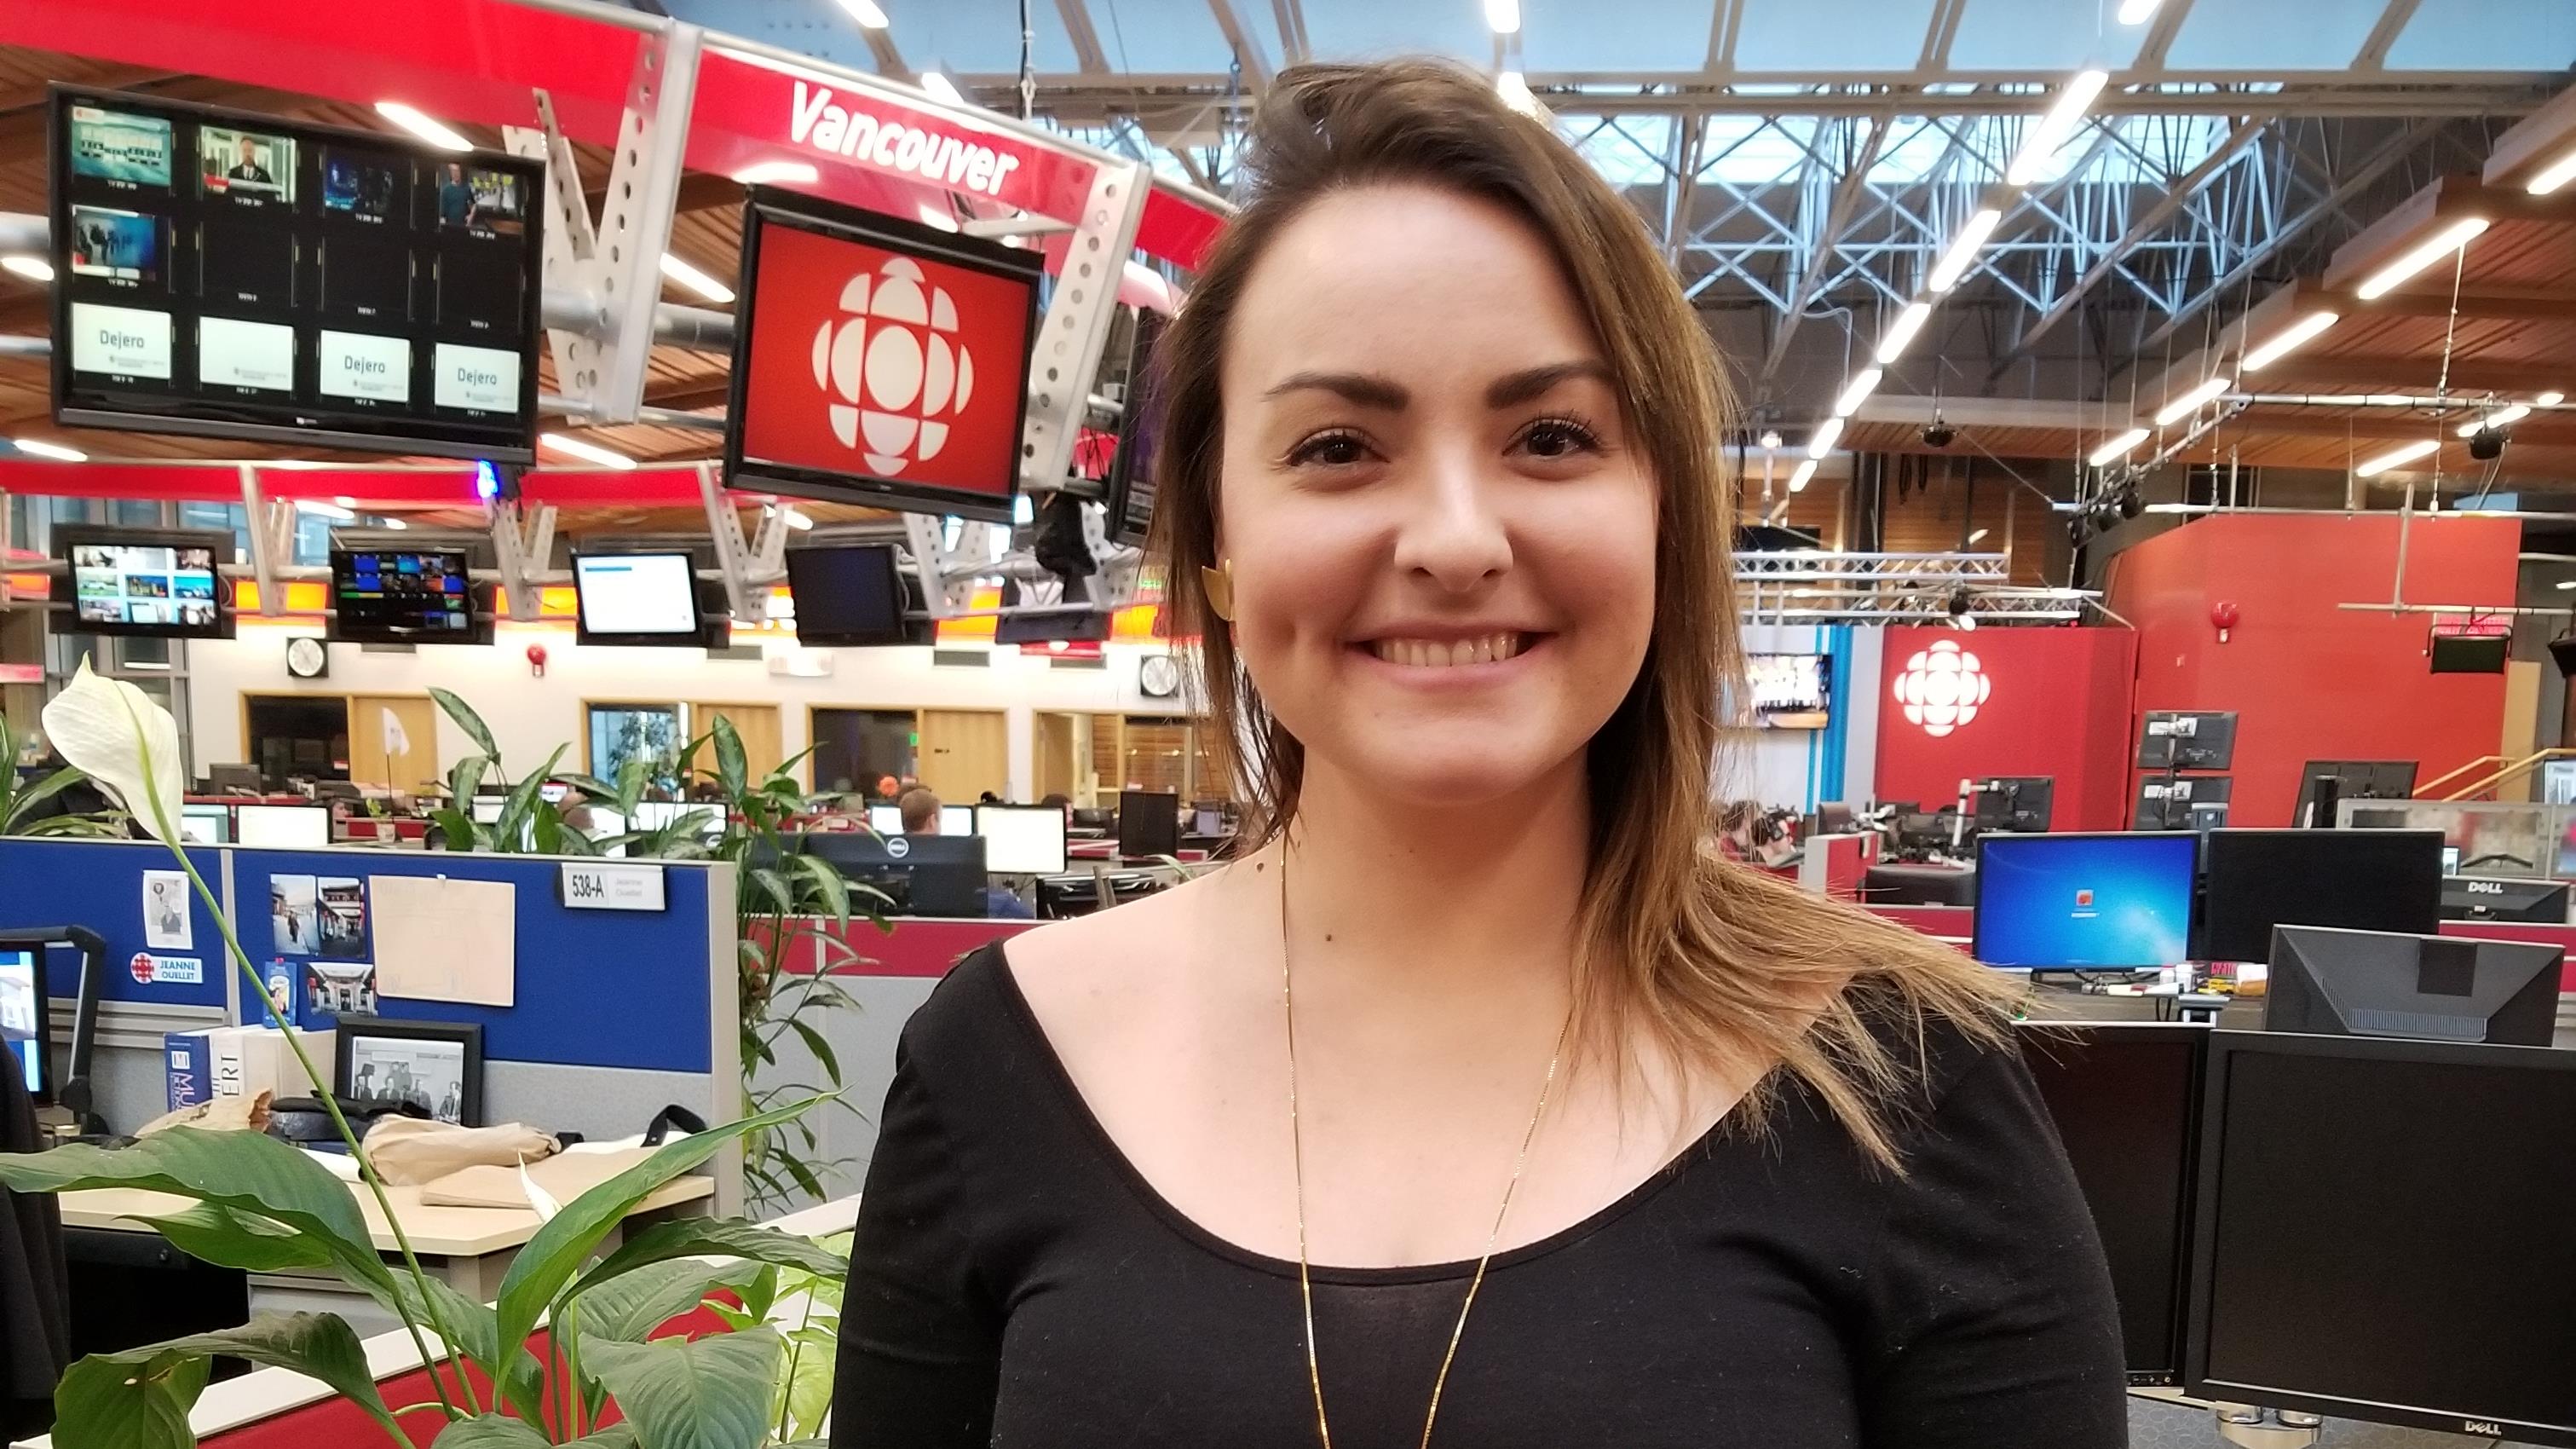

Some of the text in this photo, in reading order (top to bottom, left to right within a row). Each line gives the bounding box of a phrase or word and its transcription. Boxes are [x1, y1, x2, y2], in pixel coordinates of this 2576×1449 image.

[791, 80, 1020, 196] Vancouver
[100, 329, 145, 349] Dejero
[344, 355, 386, 374] Dejero
[458, 367, 498, 387] Dejero
[572, 875, 604, 898] 538-A
[2468, 881, 2504, 894] DELL
[160, 960, 195, 970] JEANNE
[162, 971, 194, 980] OUELLET
[2464, 1420, 2502, 1436] DELL
